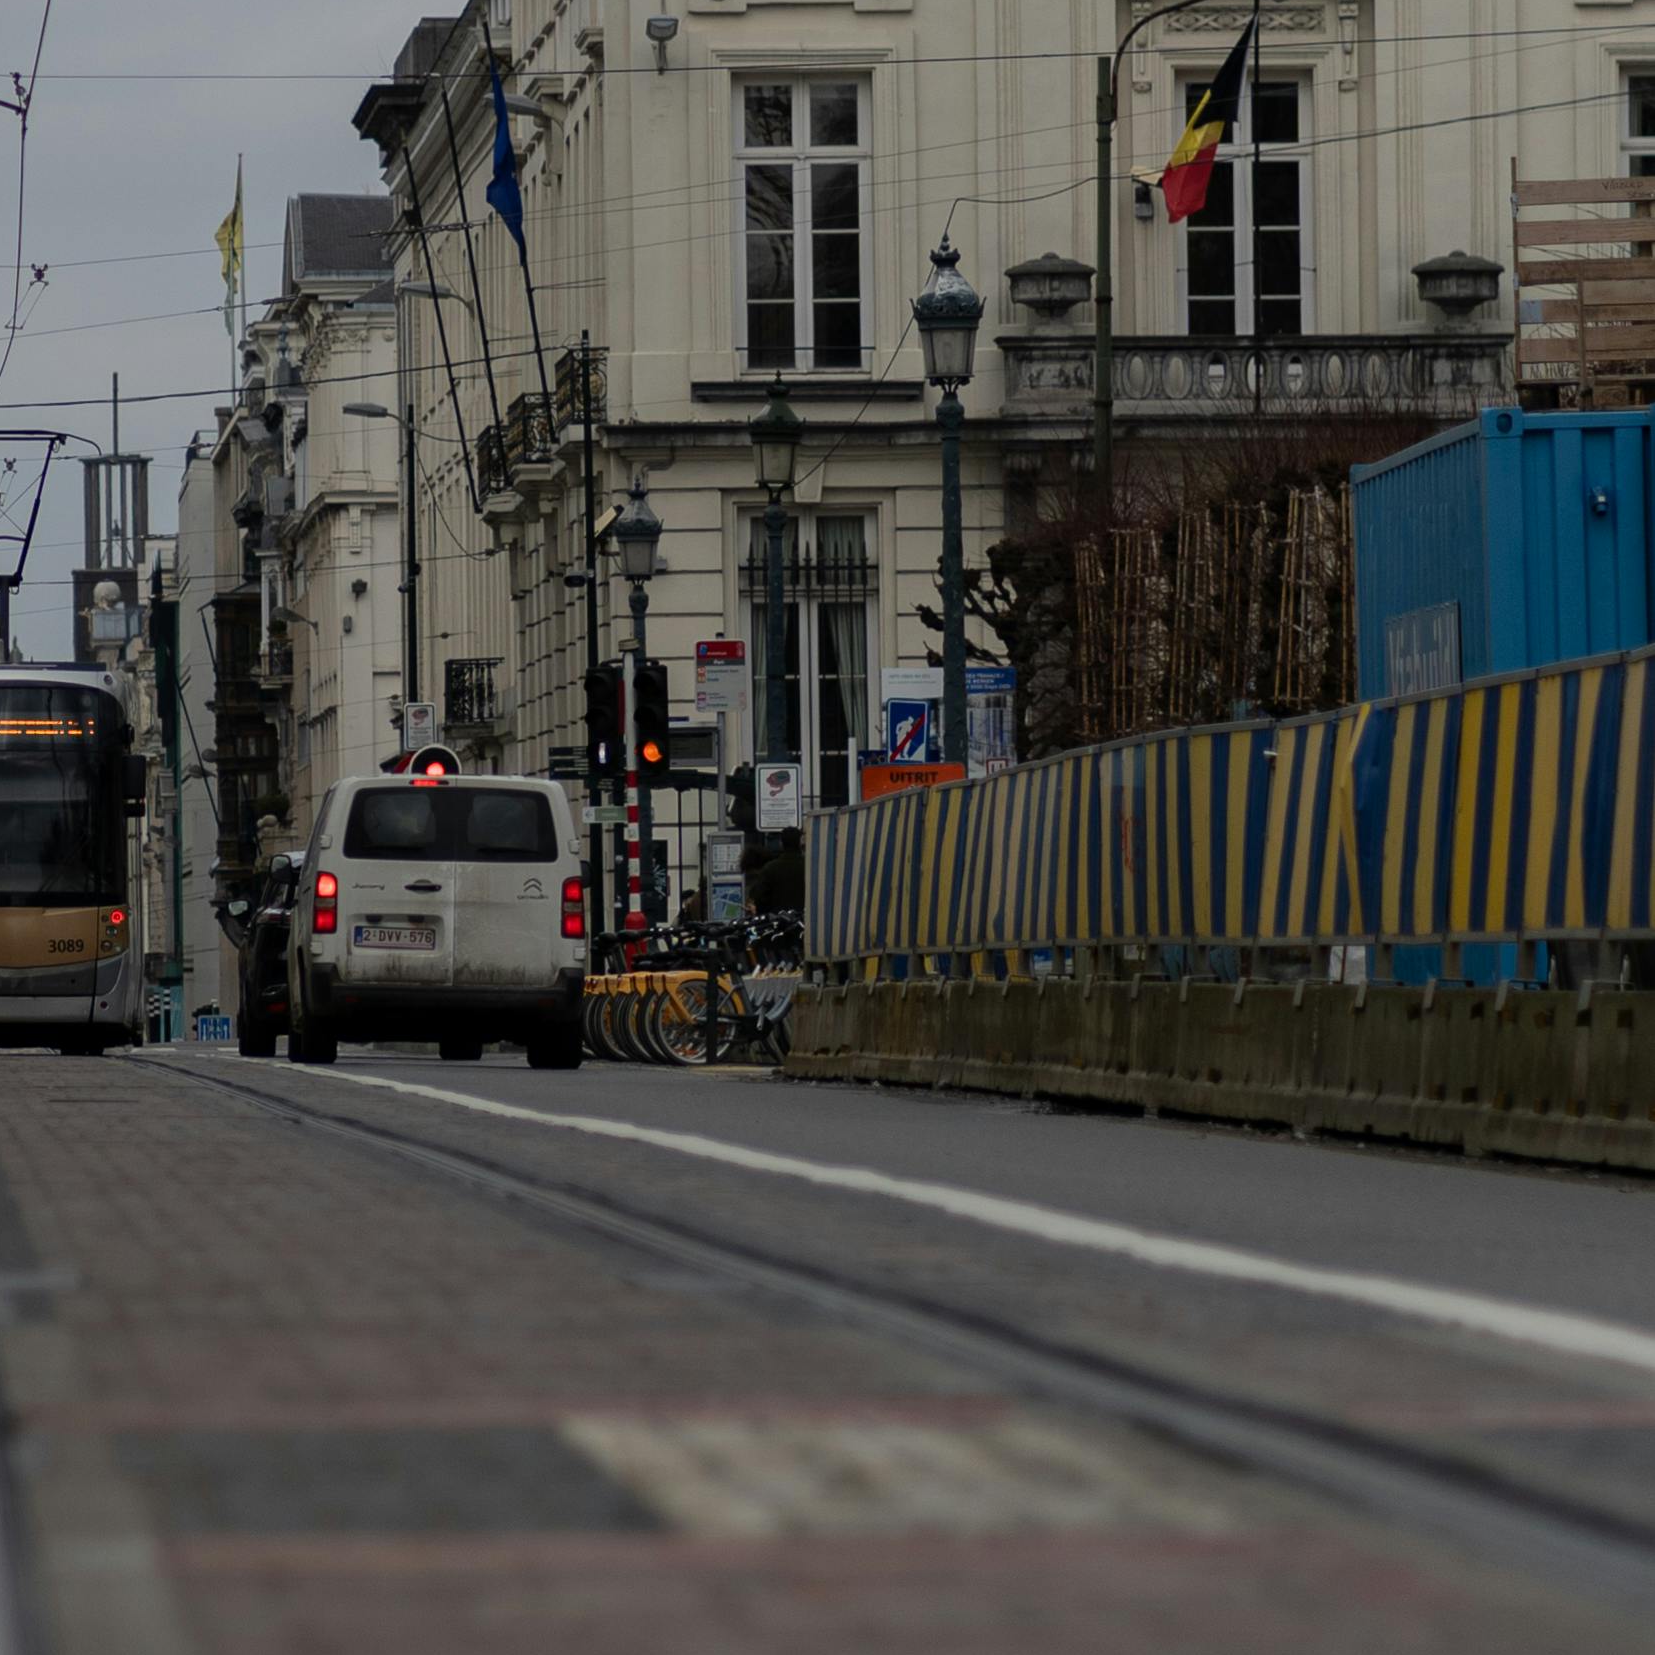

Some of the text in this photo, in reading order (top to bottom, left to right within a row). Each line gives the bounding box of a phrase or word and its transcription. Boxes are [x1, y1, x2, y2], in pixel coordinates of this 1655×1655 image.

[890, 771, 939, 783] UITRIT
[363, 929, 433, 944] 2-DVV-576
[48, 939, 84, 953] 3089
